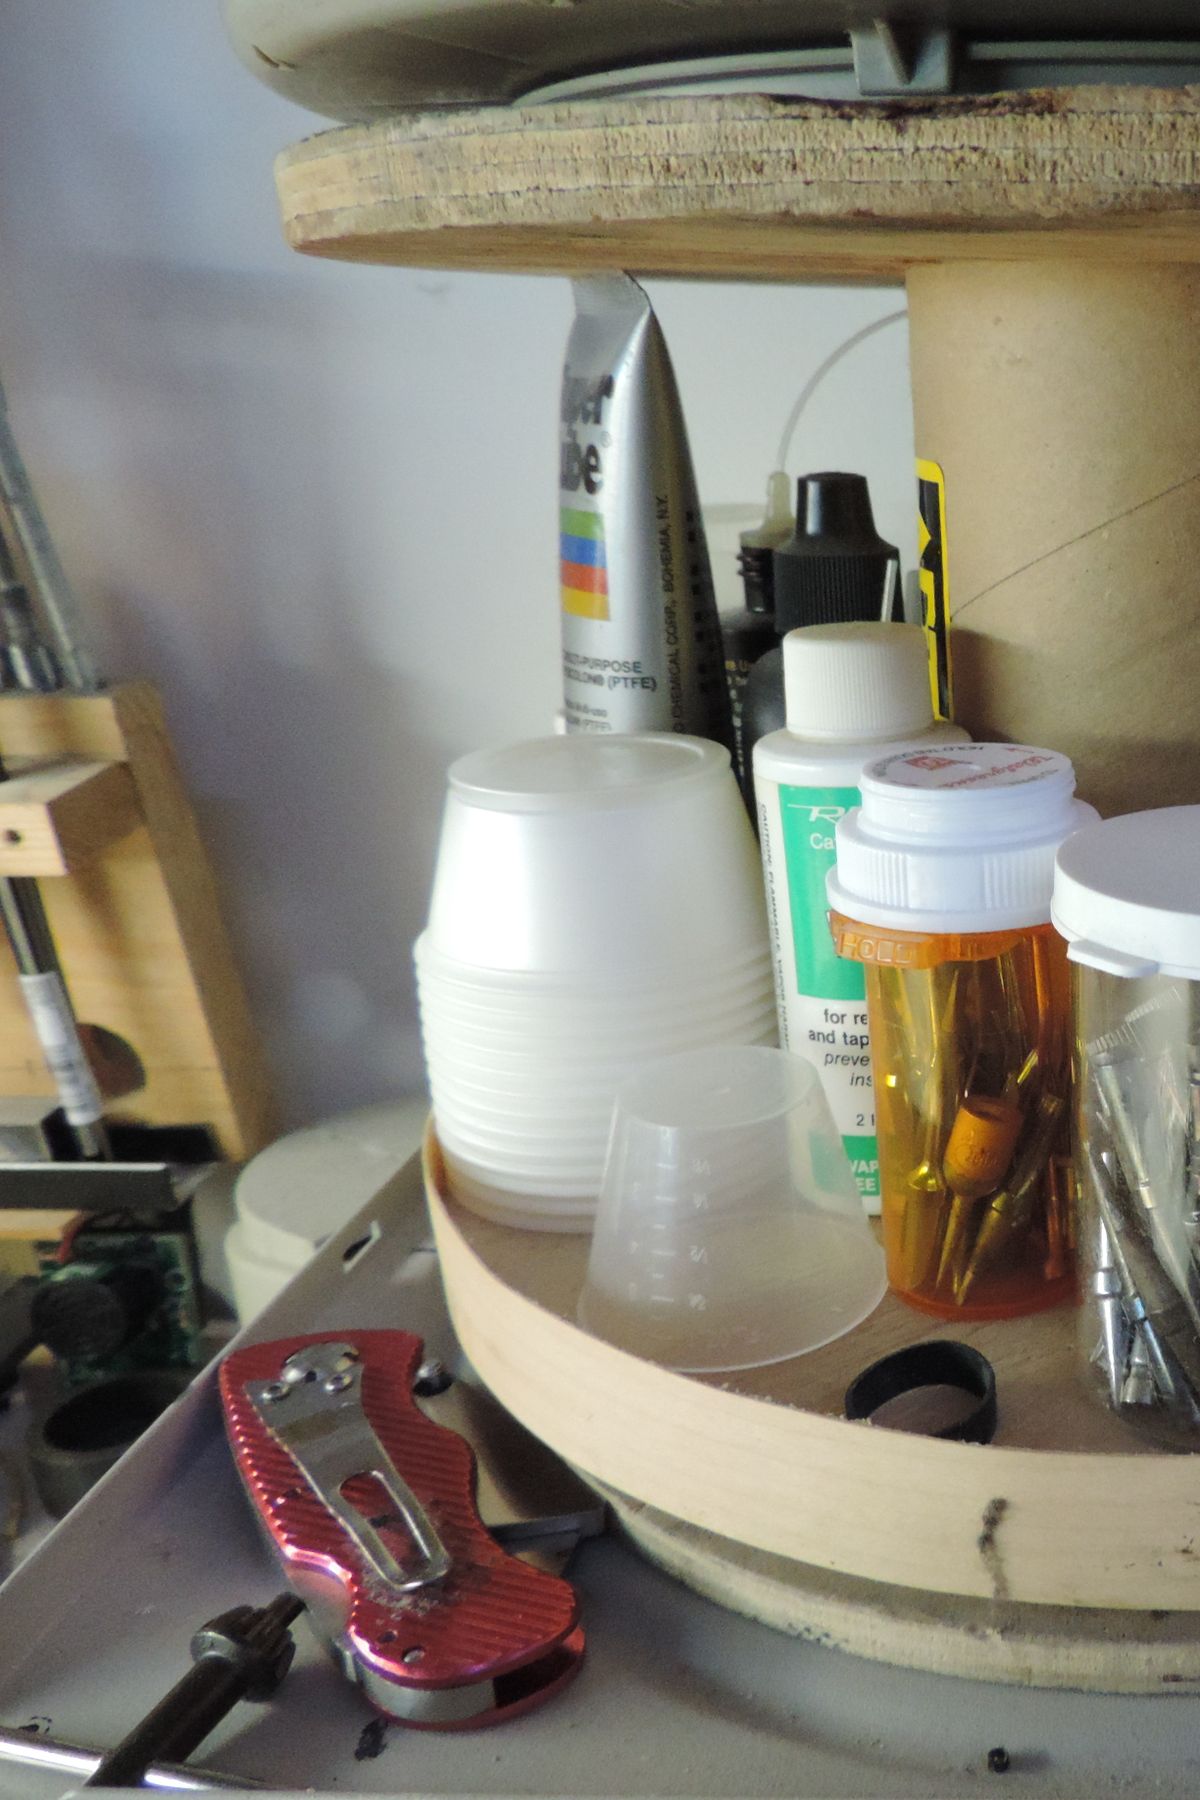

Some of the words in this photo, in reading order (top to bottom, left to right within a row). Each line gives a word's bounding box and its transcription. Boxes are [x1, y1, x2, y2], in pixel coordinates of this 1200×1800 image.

[607, 675, 658, 692] (PTFE)
[668, 649, 683, 719] CHEMICAL
[810, 833, 836, 850] Ca
[824, 1008, 847, 1025] for
[808, 1029, 835, 1044] and
